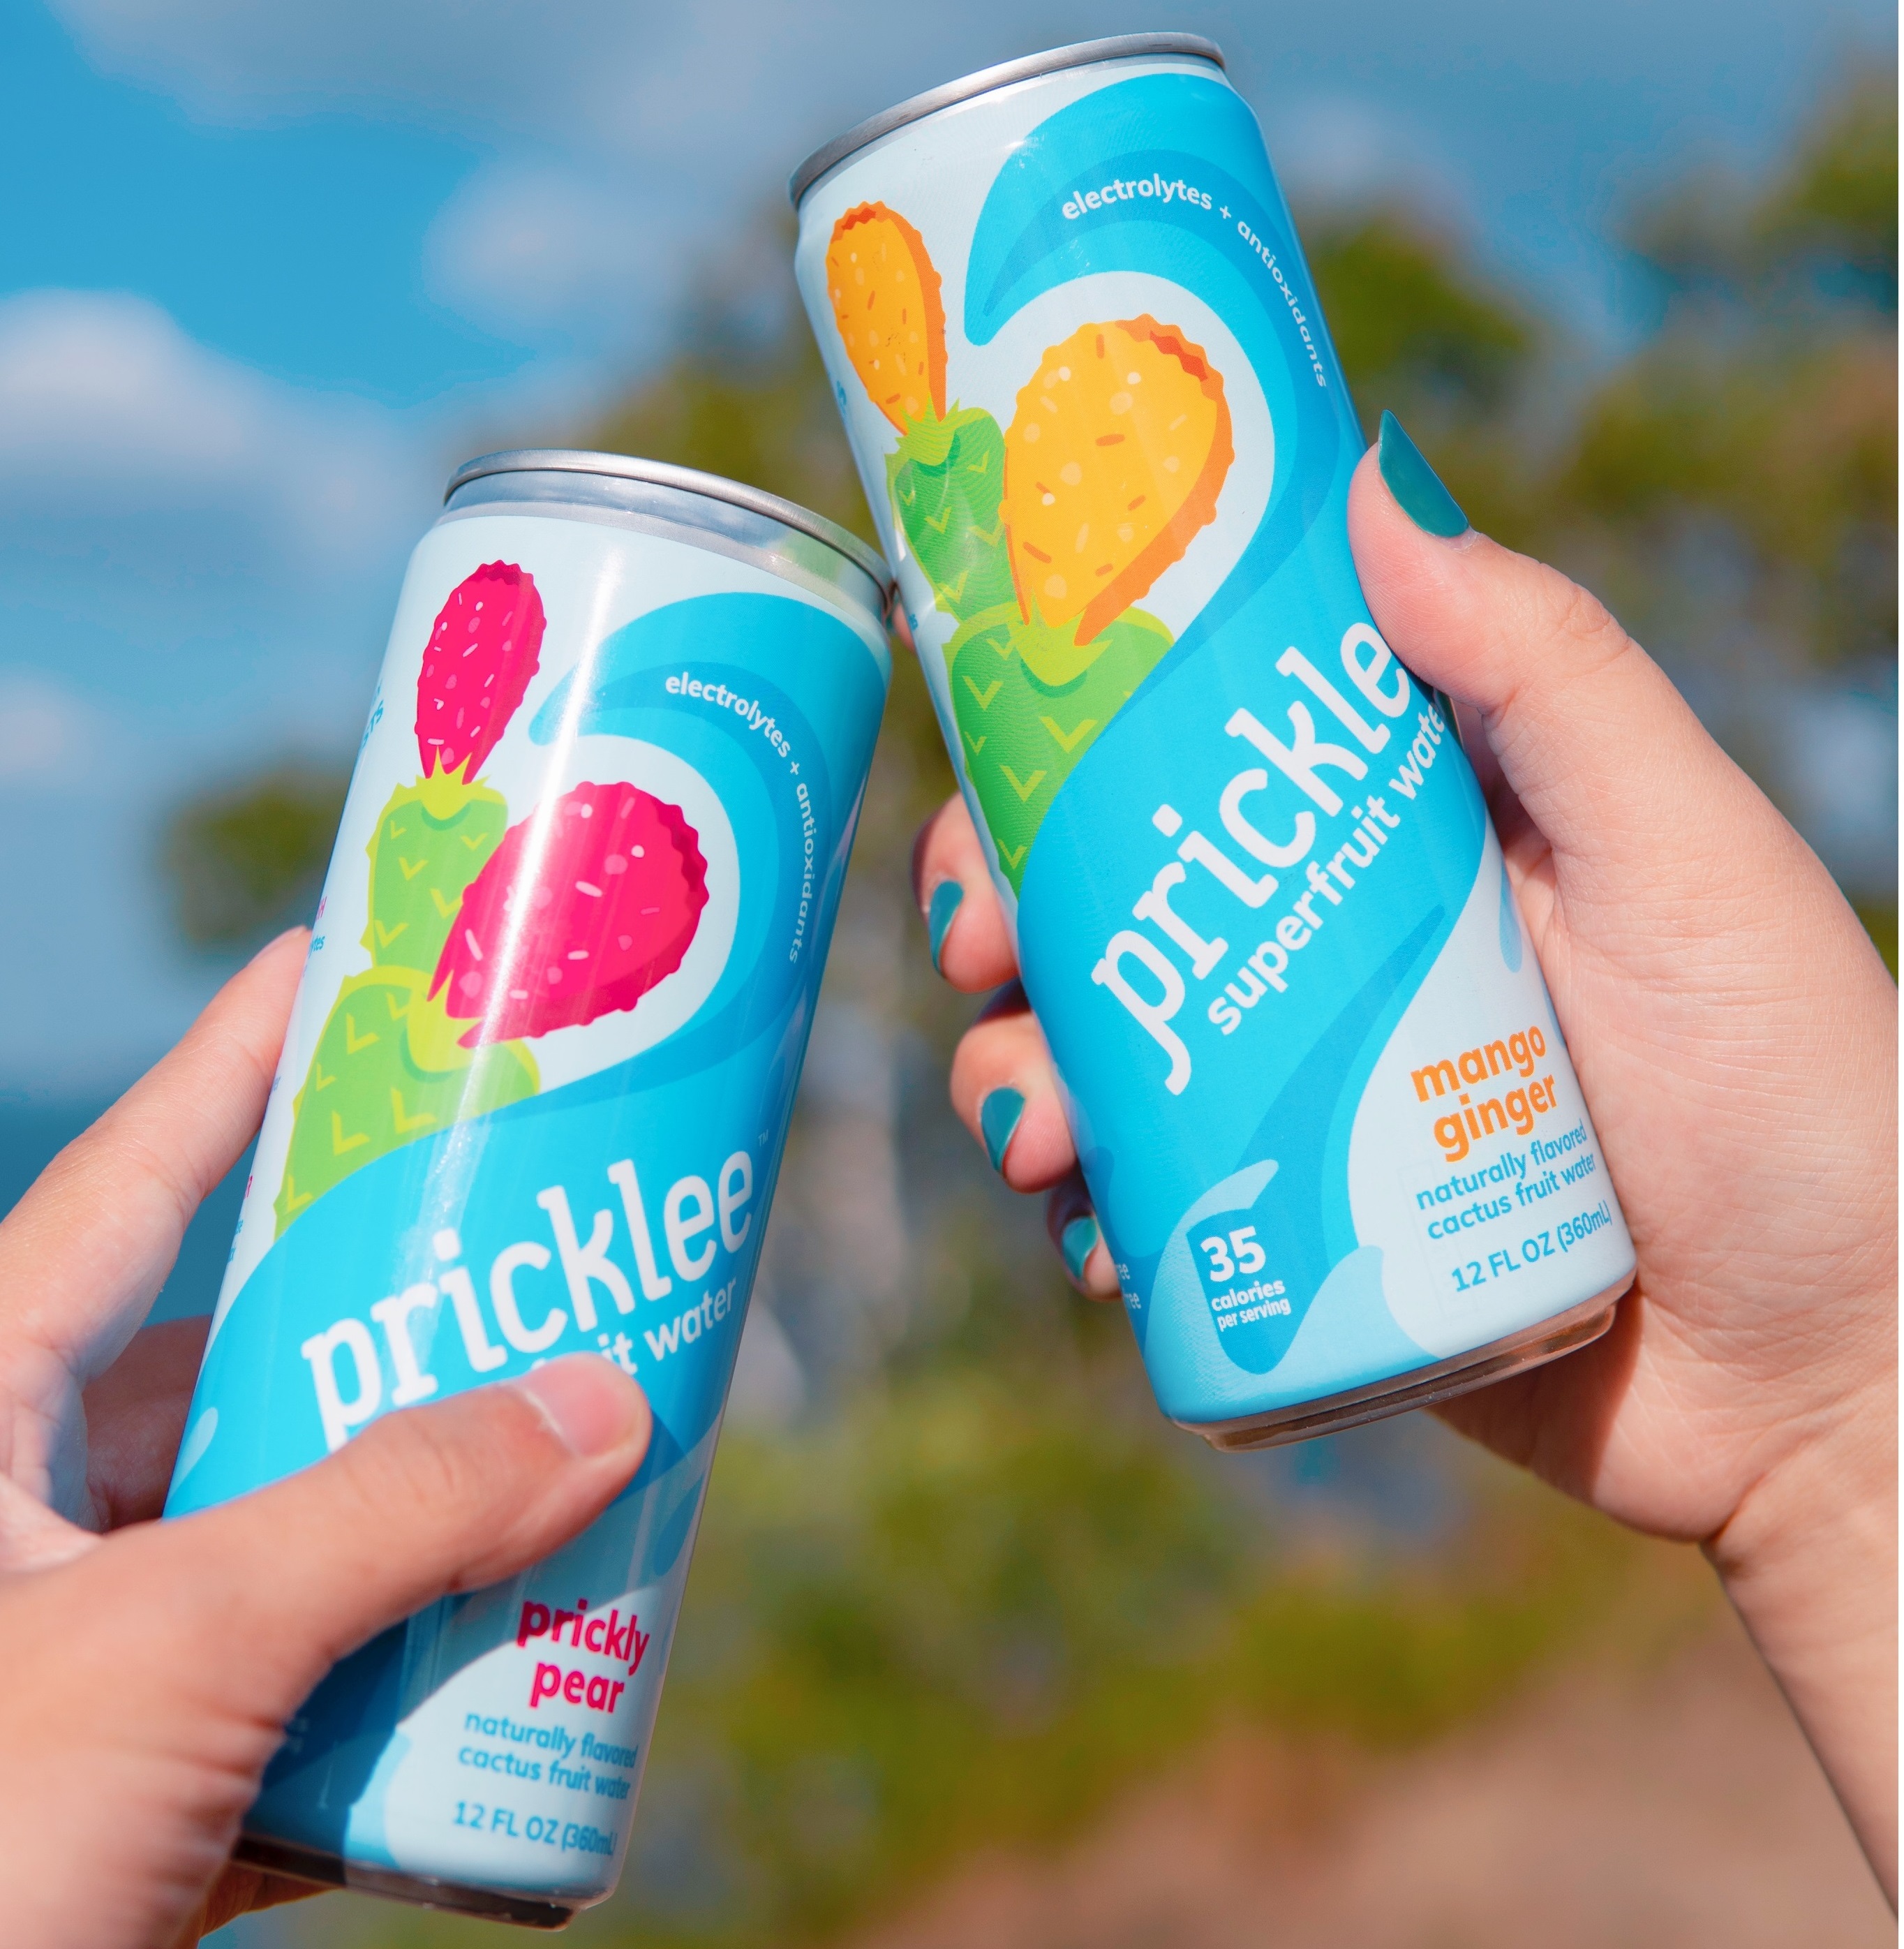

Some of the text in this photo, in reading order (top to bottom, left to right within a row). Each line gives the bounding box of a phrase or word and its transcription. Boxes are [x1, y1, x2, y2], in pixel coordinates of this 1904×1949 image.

[1062, 173, 1326, 387] electrolytes + antioxidants
[664, 672, 817, 964] electrolytes + antioxidants
[1091, 622, 1411, 1095] prickle
[1207, 704, 1445, 1035] superfruit wate
[1410, 1025, 1546, 1103] mango
[1434, 1074, 1557, 1163] ginger
[1416, 1118, 1588, 1210] naturally flavored
[1427, 1153, 1596, 1239] cactus fruit water
[1200, 1225, 1266, 1282] 35
[1451, 1200, 1612, 1292] 12 FL OZ (360mL)
[301, 1150, 753, 1453] pricklee
[643, 1277, 736, 1362] water
[1211, 1280, 1286, 1312] calories
[1217, 1298, 1291, 1333] per serving
[516, 1599, 650, 1677] prickly
[529, 1661, 625, 1713] pear
[459, 1747, 631, 1800] cactus fruit water
[465, 1713, 639, 1768] naturally flavored
[454, 1802, 485, 1830] 12
[491, 1807, 519, 1837] FL
[526, 1816, 559, 1844] OZ
